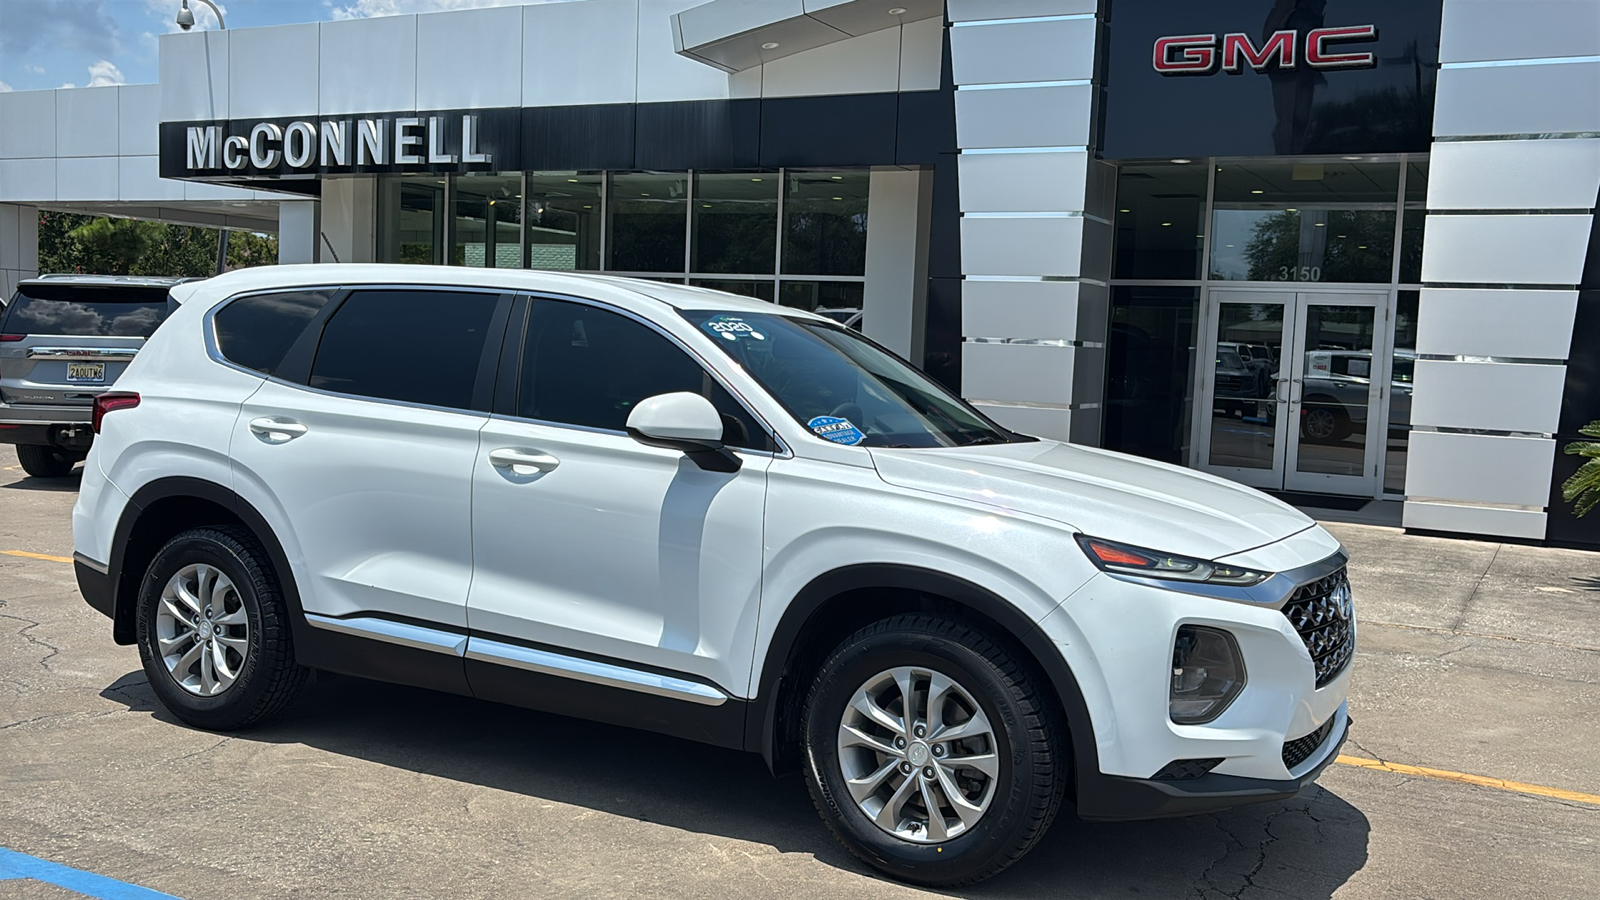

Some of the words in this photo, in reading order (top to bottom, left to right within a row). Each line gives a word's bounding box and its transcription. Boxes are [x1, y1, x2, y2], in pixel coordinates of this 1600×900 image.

[1153, 24, 1377, 76] GMC
[186, 115, 492, 170] McCONNELL
[1279, 265, 1321, 281] 3150
[708, 322, 753, 332] 2020
[816, 768, 842, 818] IRONMAN
